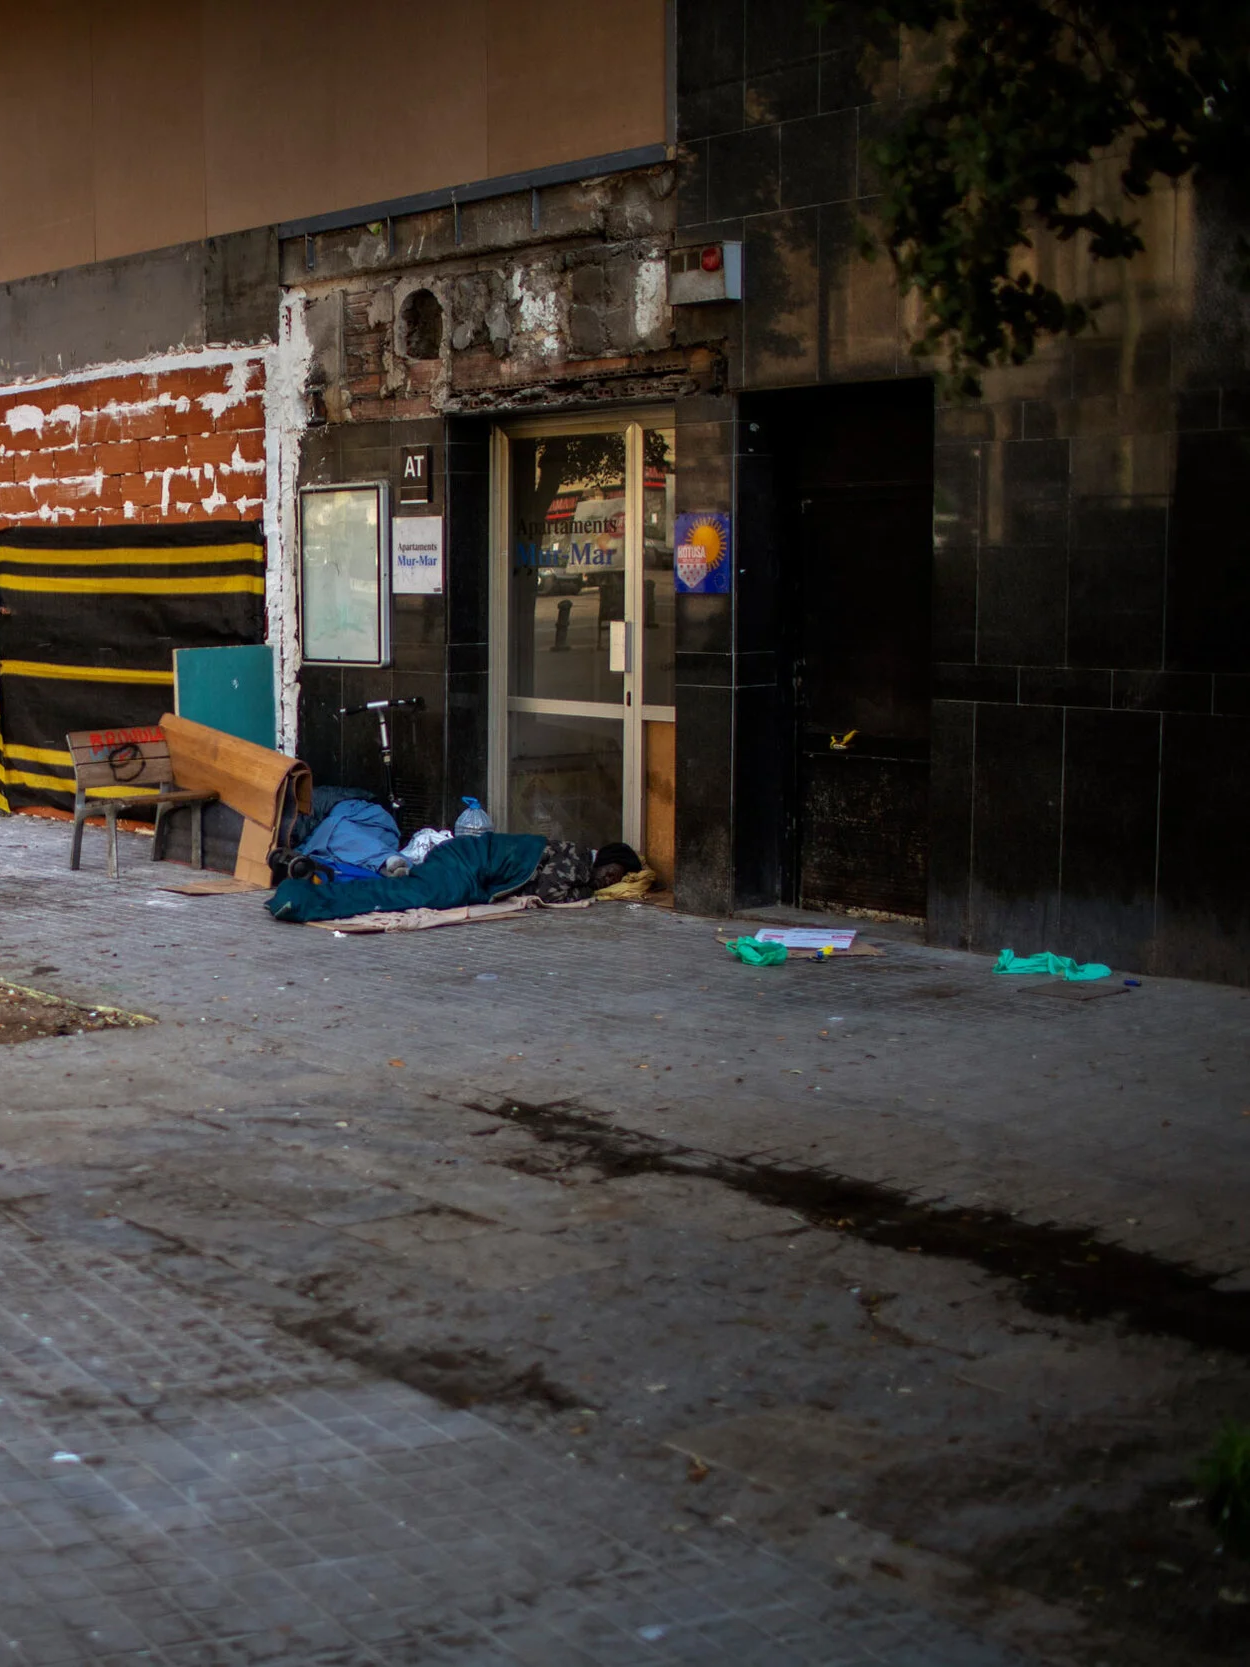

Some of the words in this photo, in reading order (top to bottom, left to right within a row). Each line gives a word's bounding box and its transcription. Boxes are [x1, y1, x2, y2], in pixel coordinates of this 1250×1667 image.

[404, 455, 425, 478] AT
[516, 517, 617, 540] Apartaments
[398, 543, 438, 554] Apartaments
[517, 542, 617, 566] Mur-Mar
[398, 556, 438, 566] Mur-Mar
